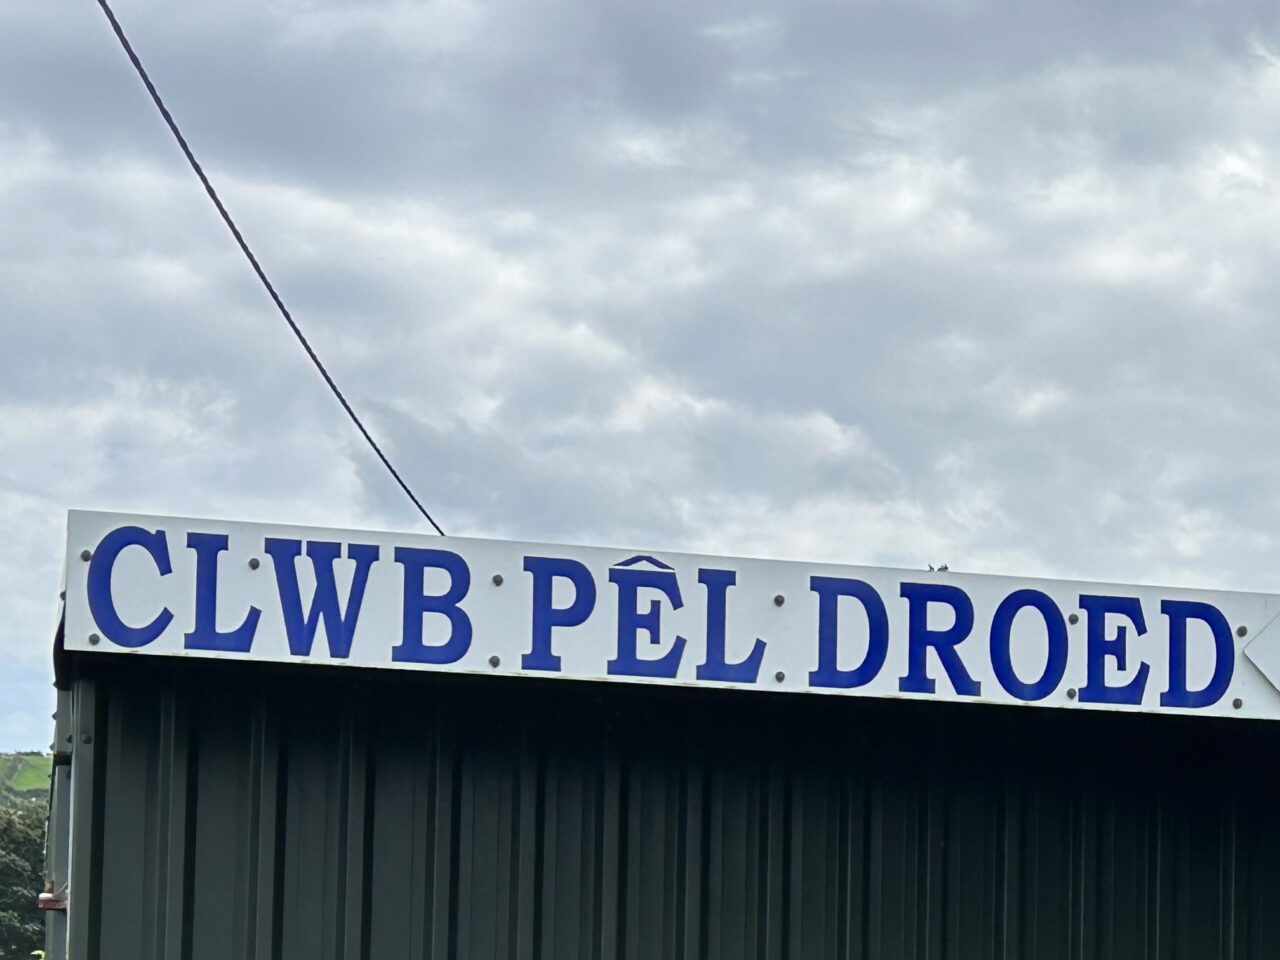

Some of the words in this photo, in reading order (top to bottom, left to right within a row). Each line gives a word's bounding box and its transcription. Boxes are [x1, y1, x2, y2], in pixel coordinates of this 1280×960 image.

[87, 526, 473, 665] CLWB
[521, 556, 766, 684] PÊL
[808, 577, 1236, 709] DROED
